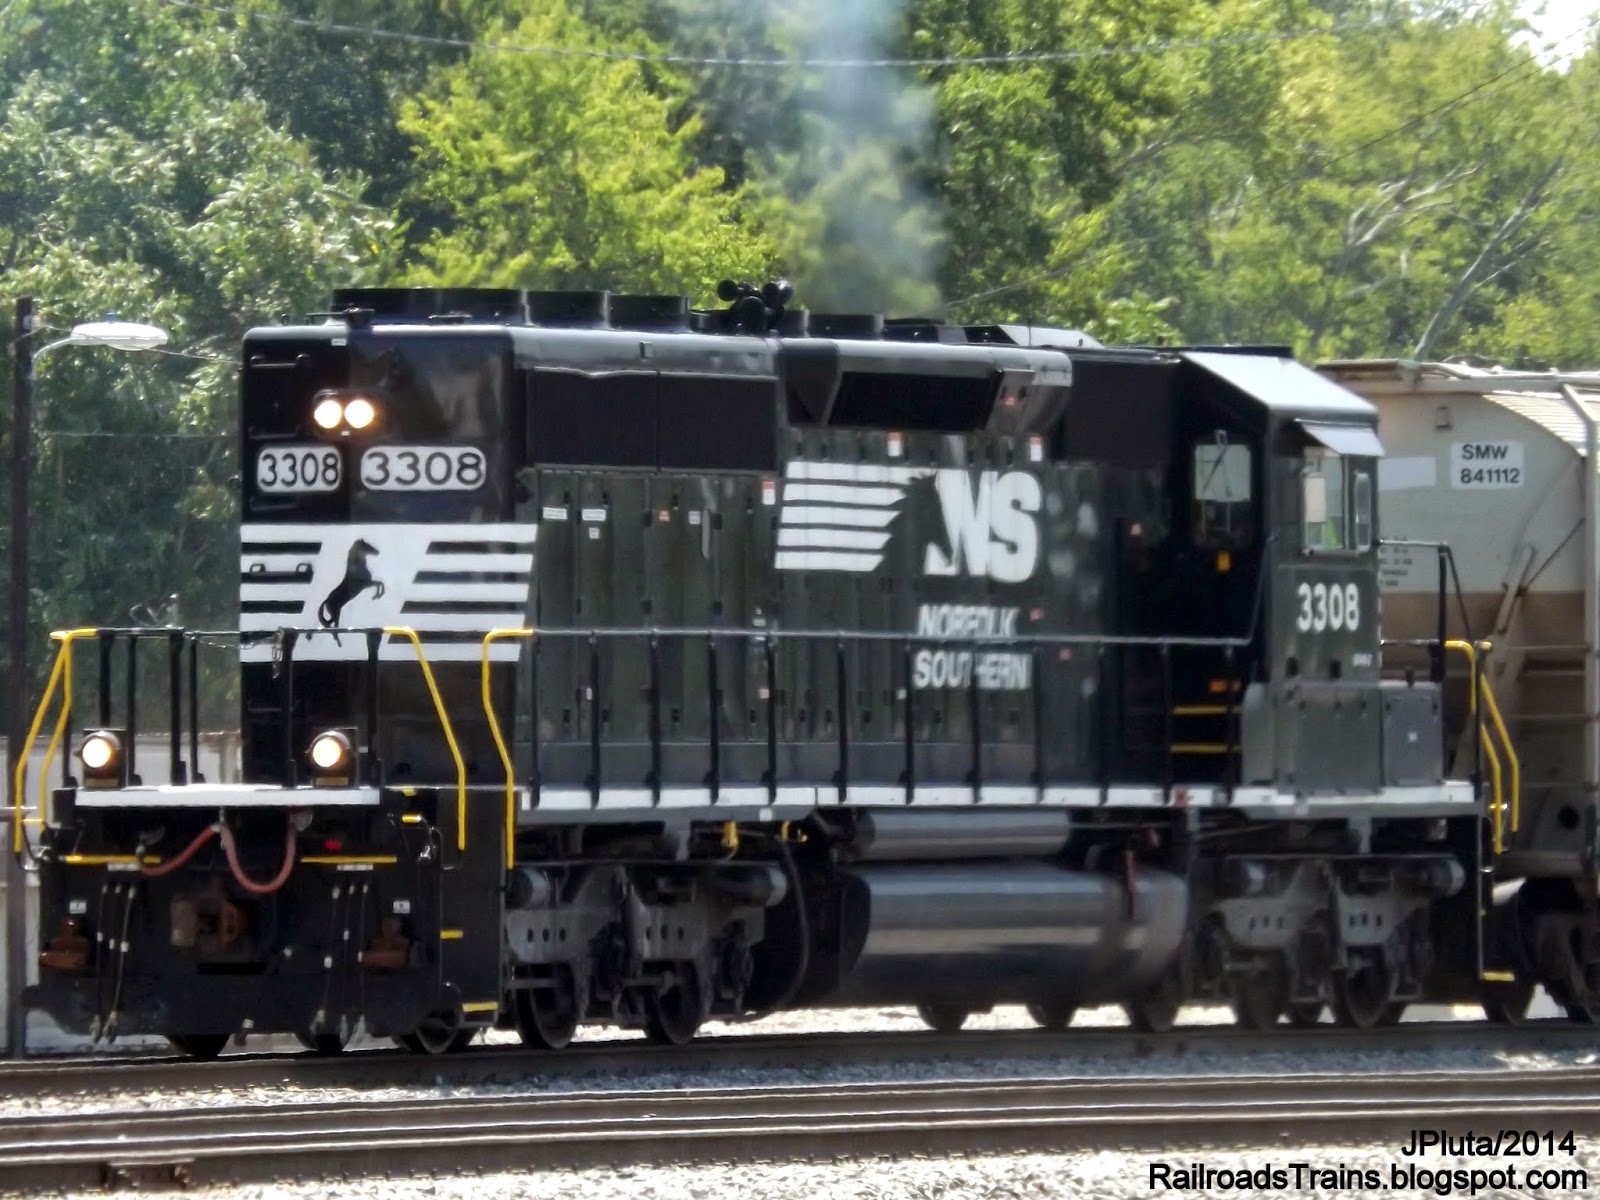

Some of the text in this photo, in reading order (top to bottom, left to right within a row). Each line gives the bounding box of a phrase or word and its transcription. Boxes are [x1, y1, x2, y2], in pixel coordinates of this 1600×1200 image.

[365, 451, 483, 486] 3308
[1462, 444, 1508, 460] SMW
[260, 453, 340, 487] 3308
[1460, 467, 1520, 484] 841112
[924, 468, 1041, 583] NS
[1297, 582, 1360, 632] 3308
